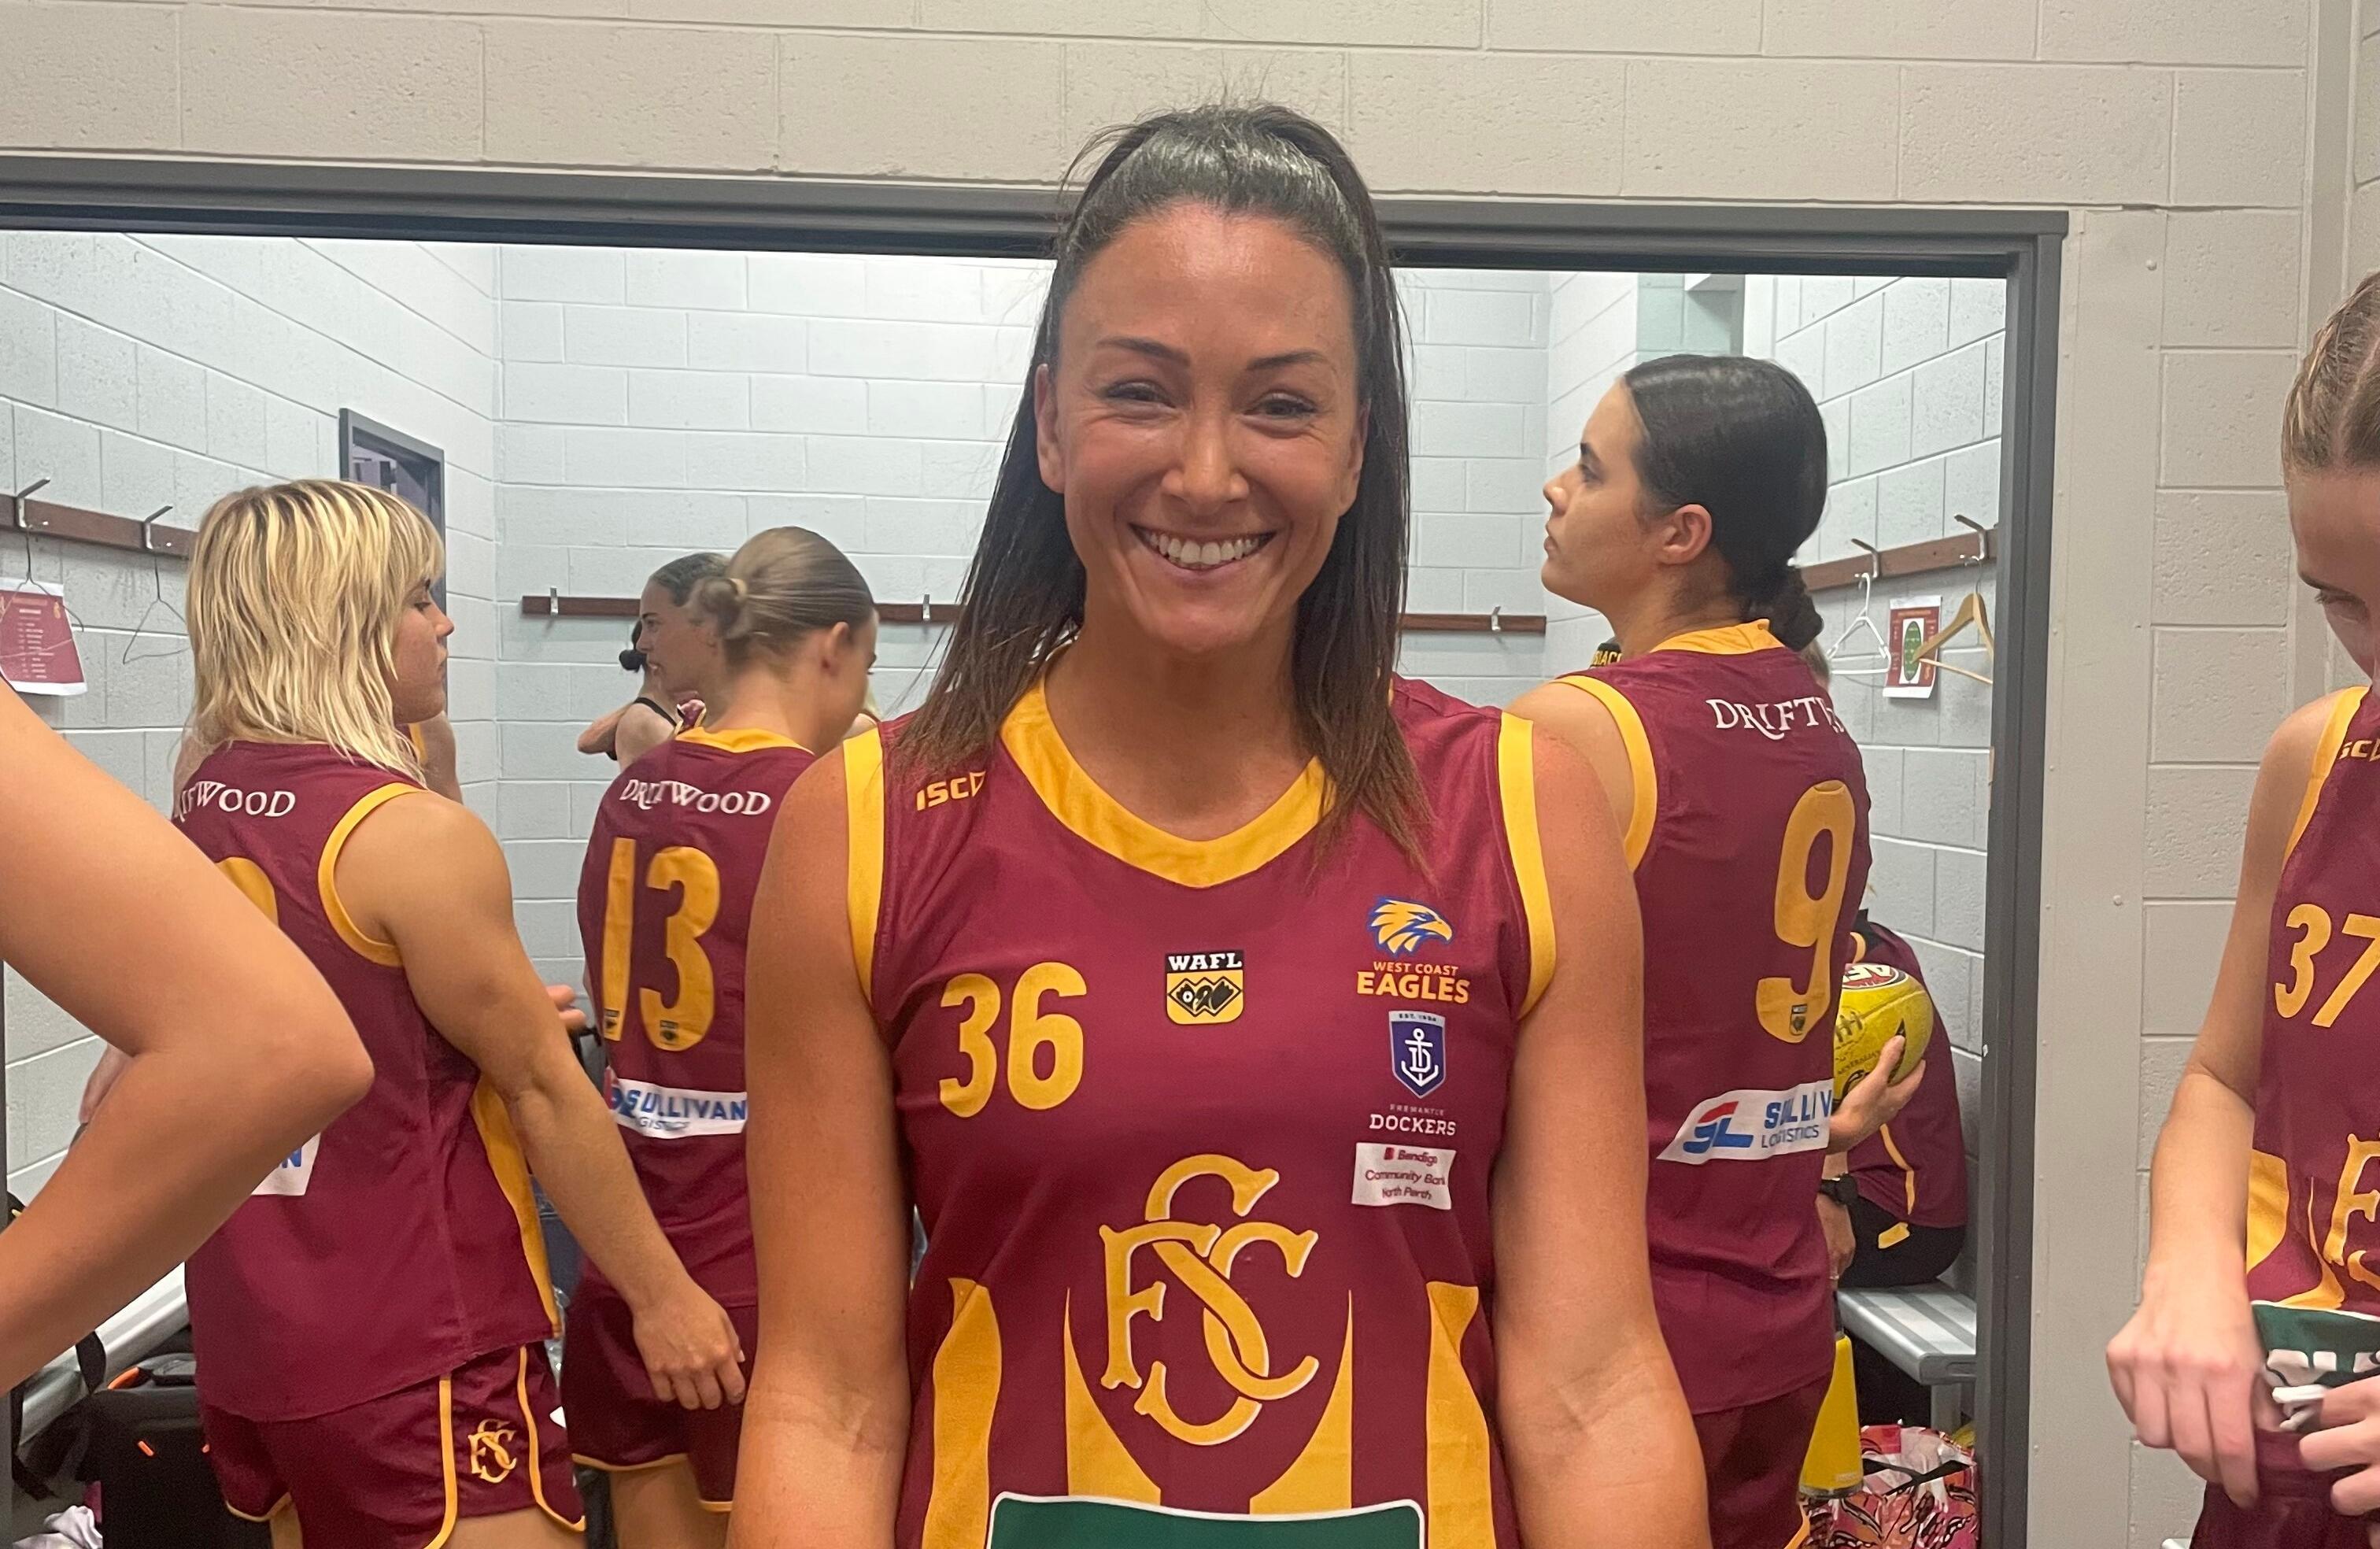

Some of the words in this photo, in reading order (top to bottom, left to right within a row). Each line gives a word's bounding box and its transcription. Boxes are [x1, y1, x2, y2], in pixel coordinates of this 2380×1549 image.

[1756, 780, 1856, 1043] 9
[602, 837, 720, 1052] 13
[1168, 952, 1242, 970] WAFL
[1373, 961, 1411, 973] WEST
[1415, 963, 1458, 975] COAST
[2275, 904, 2380, 1028] 37
[1357, 971, 1470, 1004] EAGLES
[939, 962, 1087, 1118] 36
[1369, 1114, 1456, 1135] DOCKERS
[1366, 1170, 1421, 1184] Community
